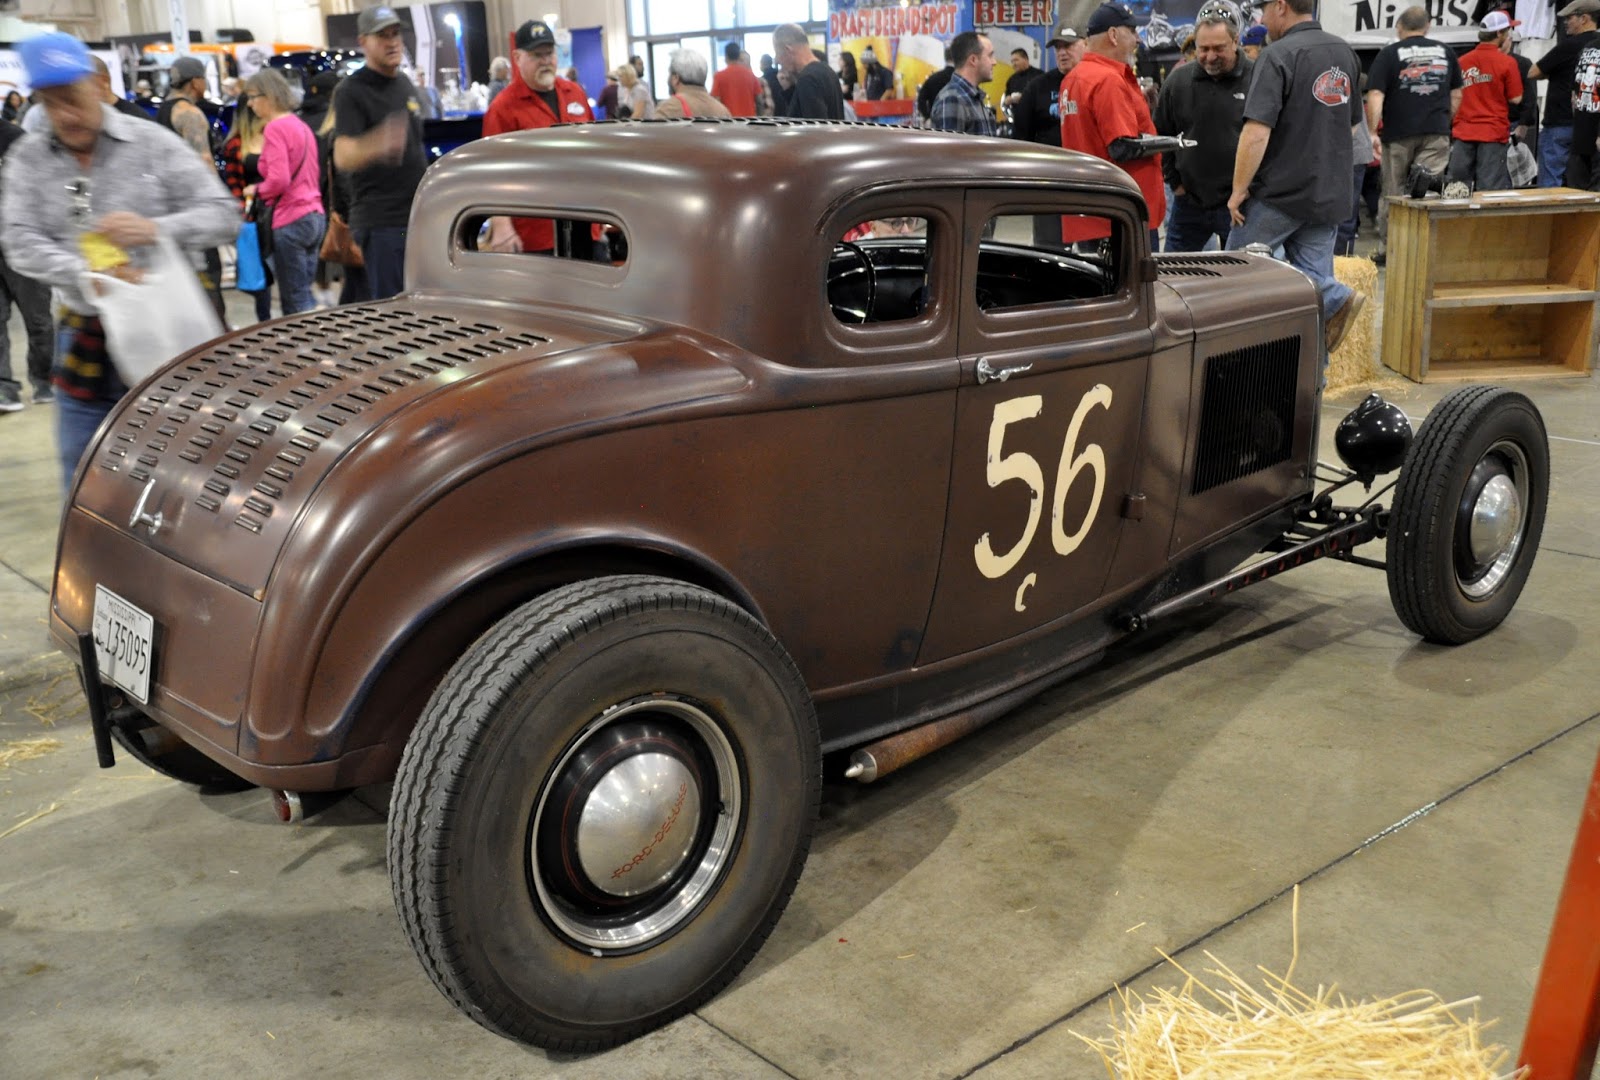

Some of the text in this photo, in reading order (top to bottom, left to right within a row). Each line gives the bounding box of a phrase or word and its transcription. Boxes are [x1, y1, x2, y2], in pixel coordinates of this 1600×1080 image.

[830, 5, 957, 39] DRAFT BEER DEPOT
[973, 0, 1053, 26] BEER
[974, 383, 1113, 578] 56
[105, 617, 148, 675] 135095
